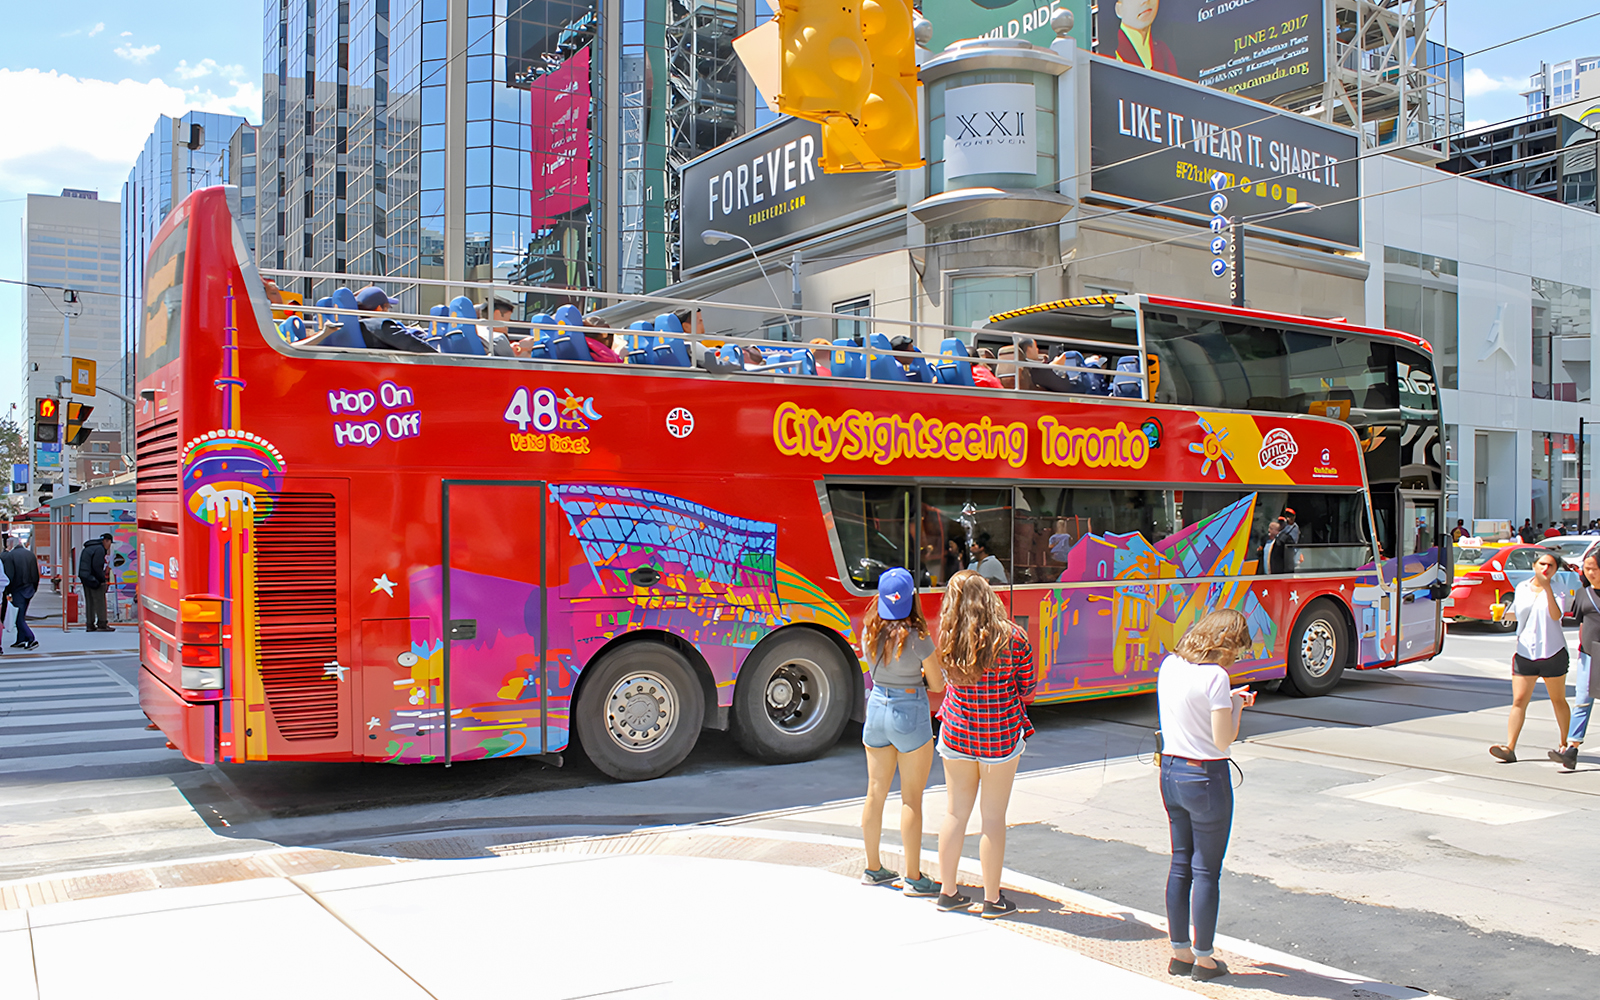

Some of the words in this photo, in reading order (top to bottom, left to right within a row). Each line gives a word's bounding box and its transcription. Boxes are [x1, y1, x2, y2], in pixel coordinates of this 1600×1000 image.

[1197, 7, 1215, 22] for
[1233, 29, 1266, 54] JUNE
[1281, 14, 1309, 36] 2017
[955, 111, 1025, 140] XXI
[1118, 98, 1162, 143] LIKE
[1167, 112, 1186, 149] IT.
[1191, 118, 1243, 164] WEAR
[1247, 134, 1265, 168] IT.
[1269, 140, 1321, 183] SHARE
[1324, 154, 1340, 187] IT.
[708, 134, 816, 221] FOREVER
[328, 389, 376, 415] Hop
[379, 381, 413, 408] On
[504, 386, 558, 432] 48
[334, 421, 382, 447] Hop
[385, 411, 421, 441] Off
[774, 402, 1028, 468] CitySightseeing
[1037, 415, 1150, 469] Toronto
